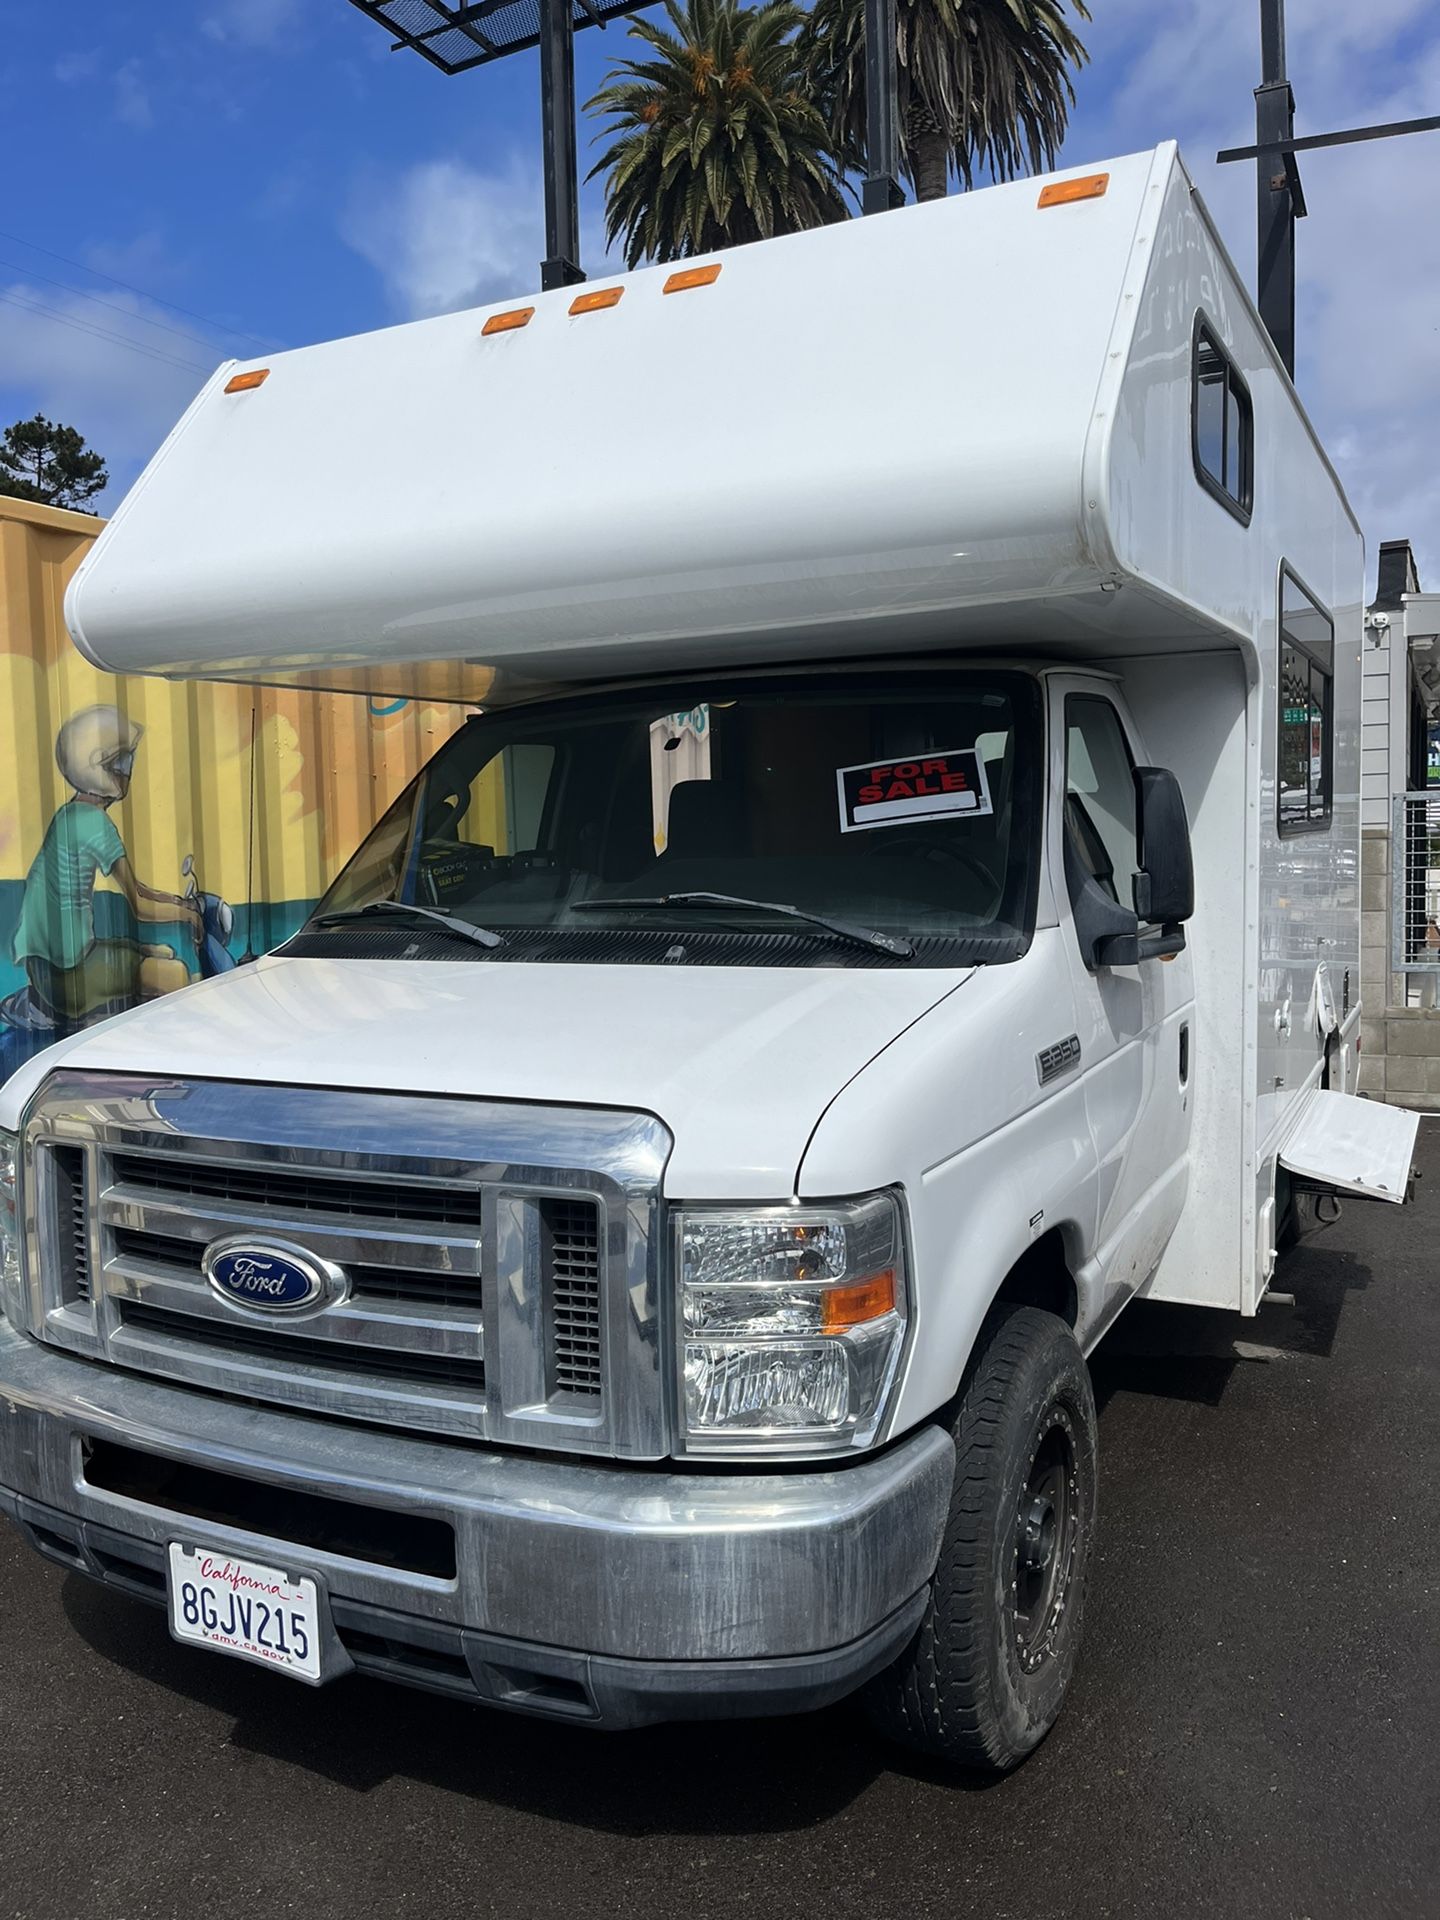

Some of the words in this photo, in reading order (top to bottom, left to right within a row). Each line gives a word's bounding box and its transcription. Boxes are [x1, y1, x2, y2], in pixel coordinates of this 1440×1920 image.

[858, 772, 968, 804] SALE
[871, 759, 948, 784] FOR
[229, 1258, 288, 1296] Ford
[201, 1558, 290, 1601] California
[181, 1582, 308, 1660] 8GJV215
[211, 1632, 285, 1662] dmv.ca.gov
